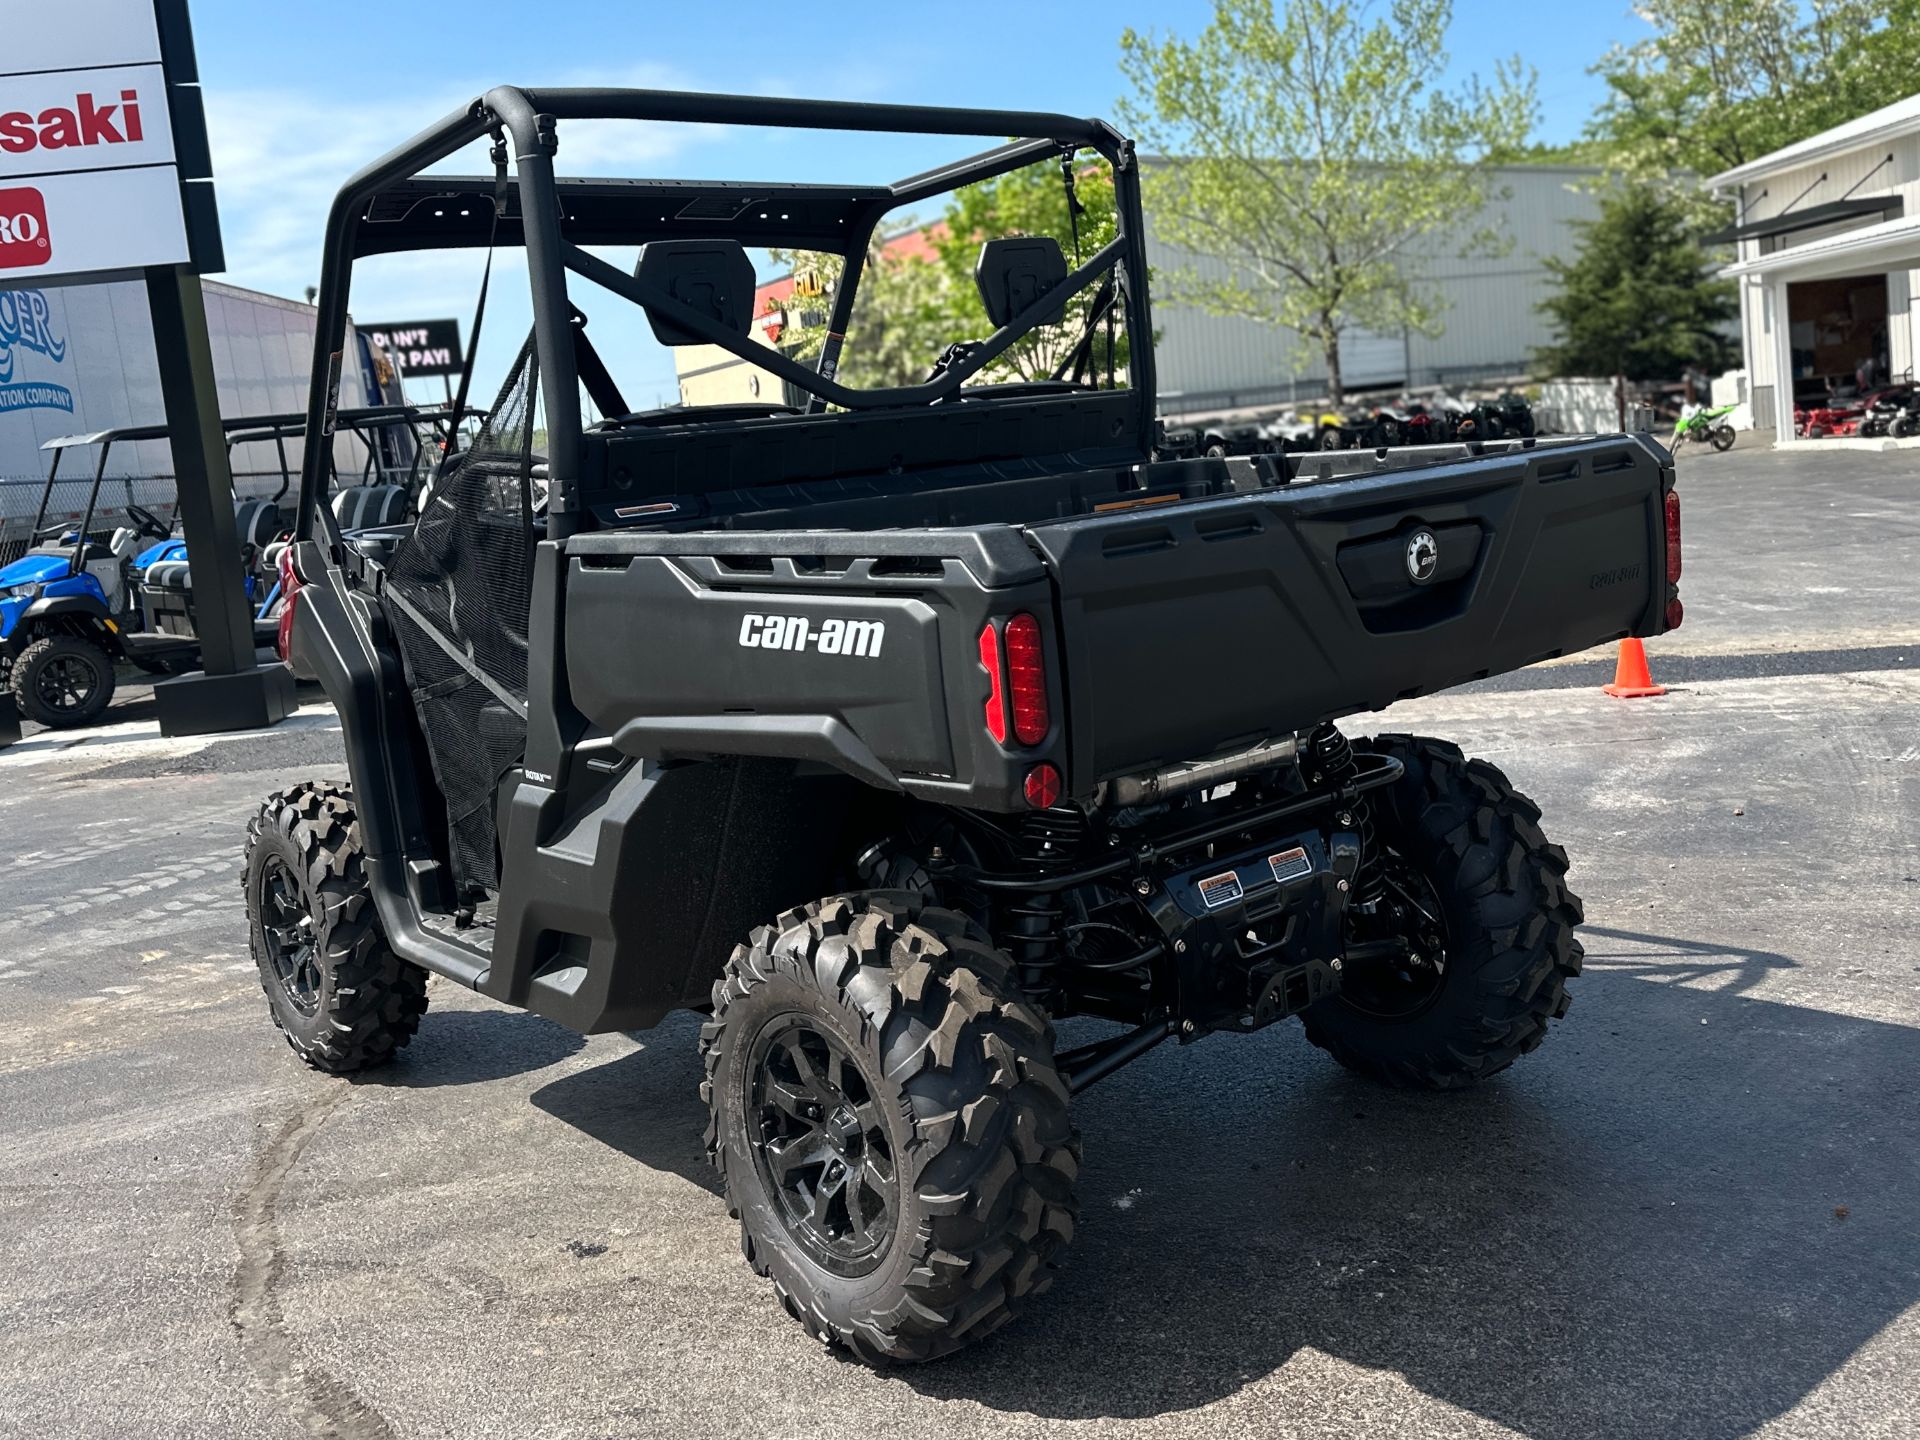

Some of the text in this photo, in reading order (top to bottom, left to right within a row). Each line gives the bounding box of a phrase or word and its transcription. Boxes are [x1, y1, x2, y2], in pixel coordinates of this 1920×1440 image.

[409, 348, 451, 366] PAY!
[25, 388, 70, 407] COMPANY
[739, 614, 885, 657] can-am
